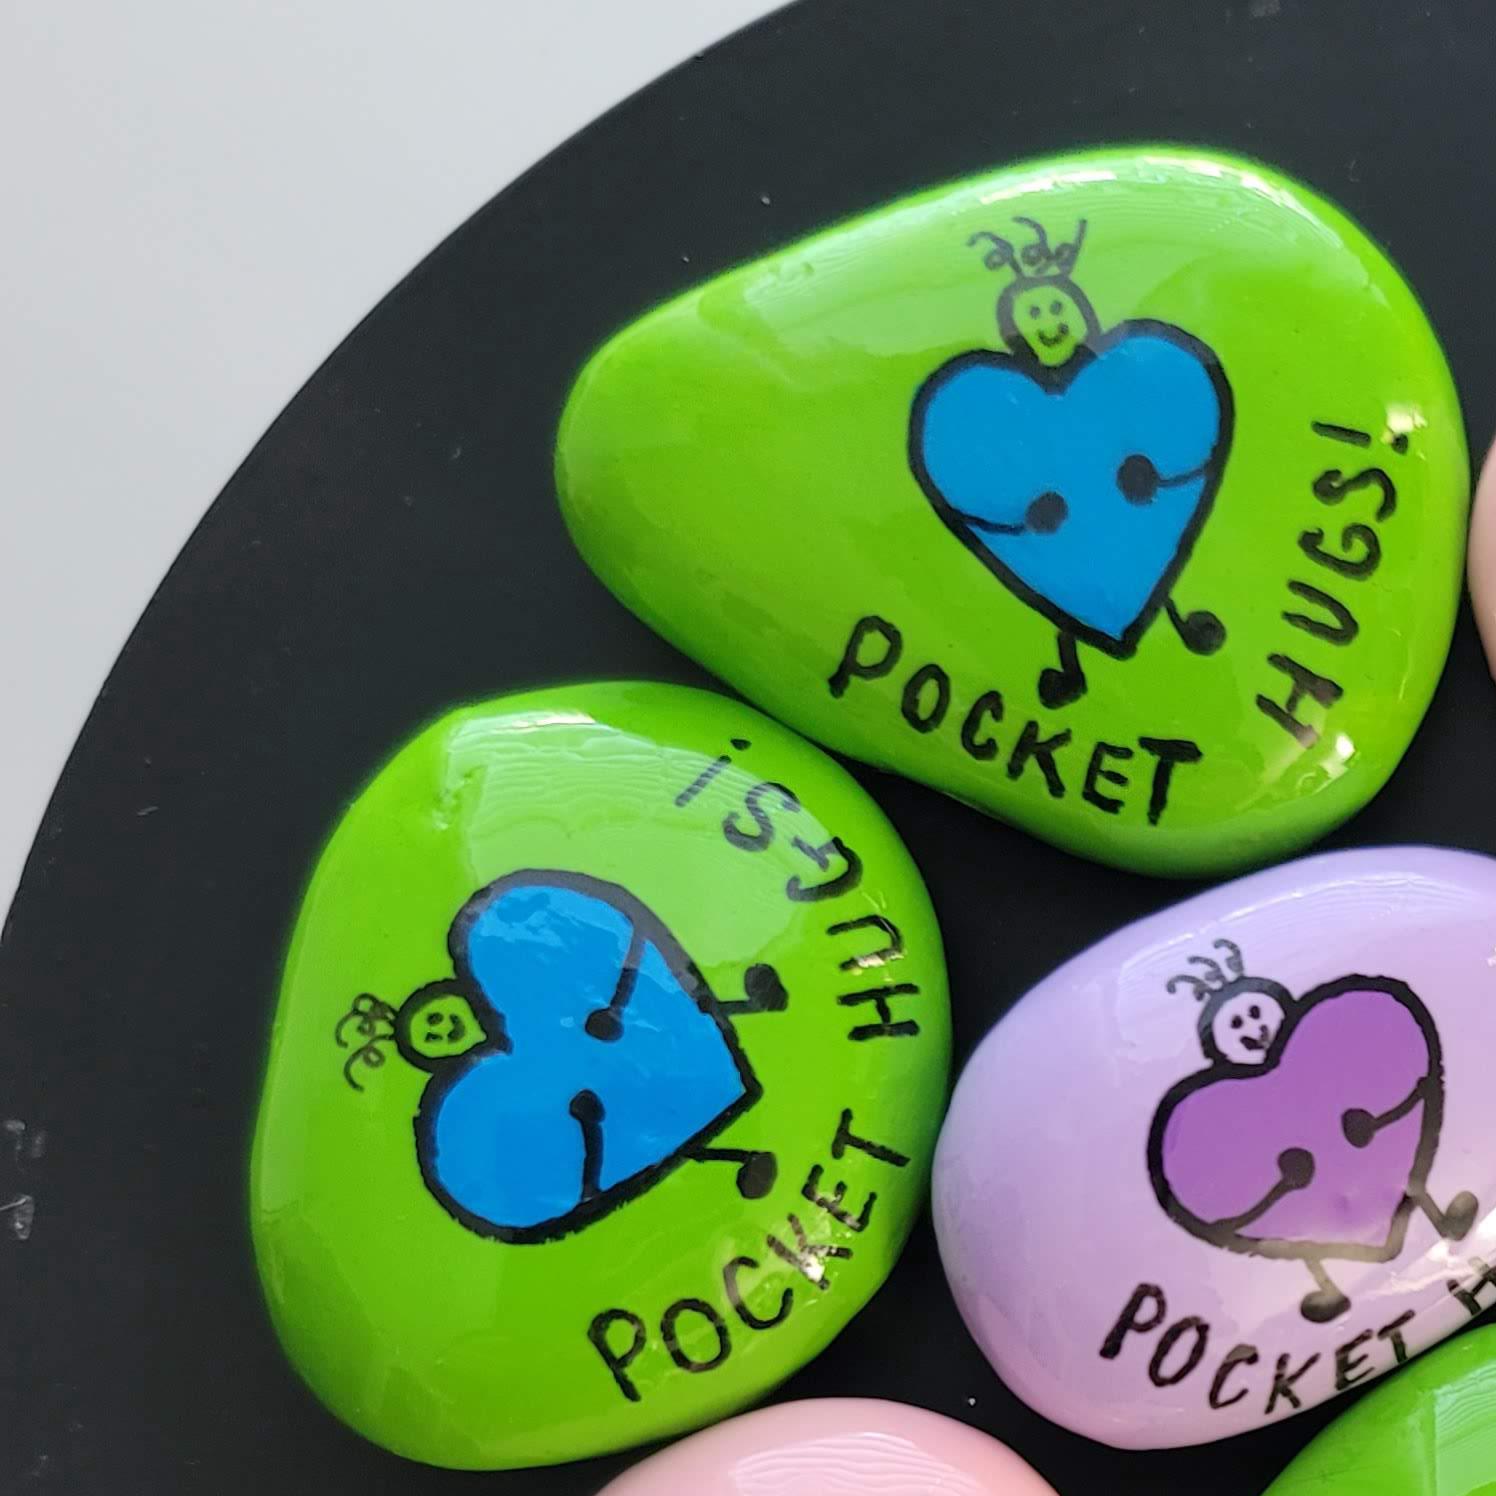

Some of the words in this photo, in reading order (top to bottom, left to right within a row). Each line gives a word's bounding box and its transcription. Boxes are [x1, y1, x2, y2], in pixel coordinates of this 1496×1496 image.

[827, 614, 1203, 825] POCKET
[1254, 420, 1410, 749] HUGS!
[674, 738, 921, 1041] HUGS!
[587, 1107, 911, 1402] POCKET
[1098, 1282, 1416, 1416] POCKET
